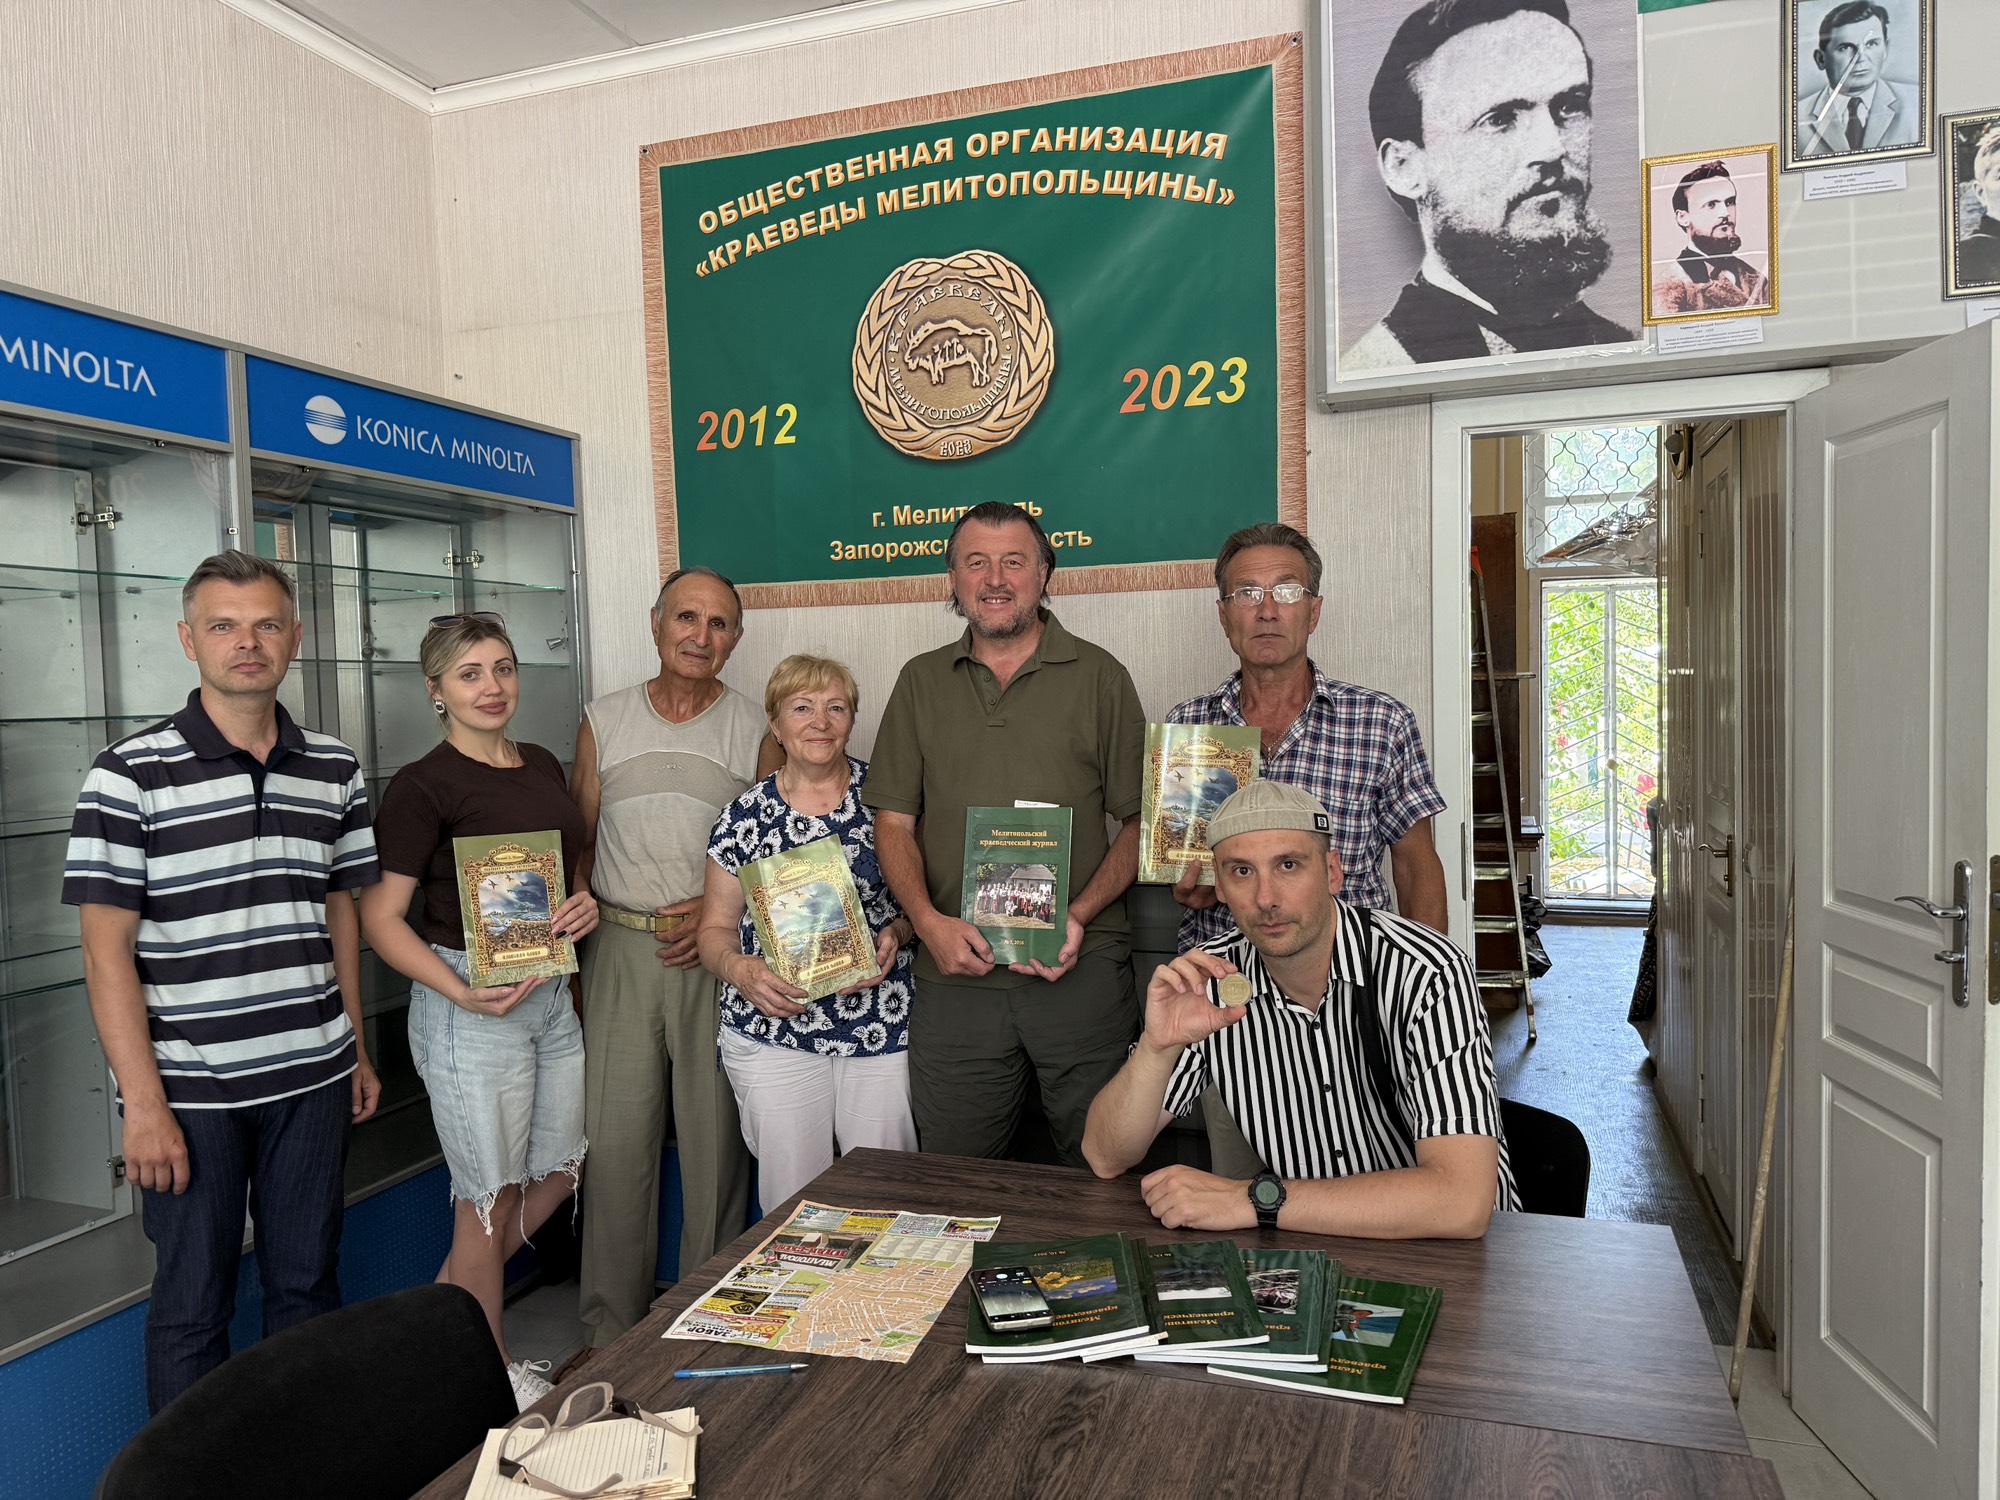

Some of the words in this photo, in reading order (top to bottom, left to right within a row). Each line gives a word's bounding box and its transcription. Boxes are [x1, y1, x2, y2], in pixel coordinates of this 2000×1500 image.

[698, 137, 954, 234] ОБЩЕСТВЕННАЯ
[966, 126, 1229, 160] ОРГАНИЗАЦИЯ
[695, 196, 867, 278] «КРАЕВЕДЫ
[876, 169, 1236, 215] МЕЛИТОПОЛЬЩИНЫ»
[888, 283, 1013, 353] КРАЕВЕДЫ
[0, 335, 157, 397] MINOLTA
[889, 354, 1012, 420] МЕЛИТОПОЛЬЩИНЫ
[1120, 356, 1247, 414] 2023
[357, 414, 444, 458] KONICA
[451, 437, 536, 477] MINOLTA
[696, 403, 798, 451] 2012
[940, 439, 973, 457] 2023
[872, 511, 886, 527] г.
[830, 539, 949, 562] Запорожс
[979, 839, 1031, 848] краеведческий
[1031, 840, 1058, 848] журнал
[991, 829, 1047, 838] Мелитопольский
